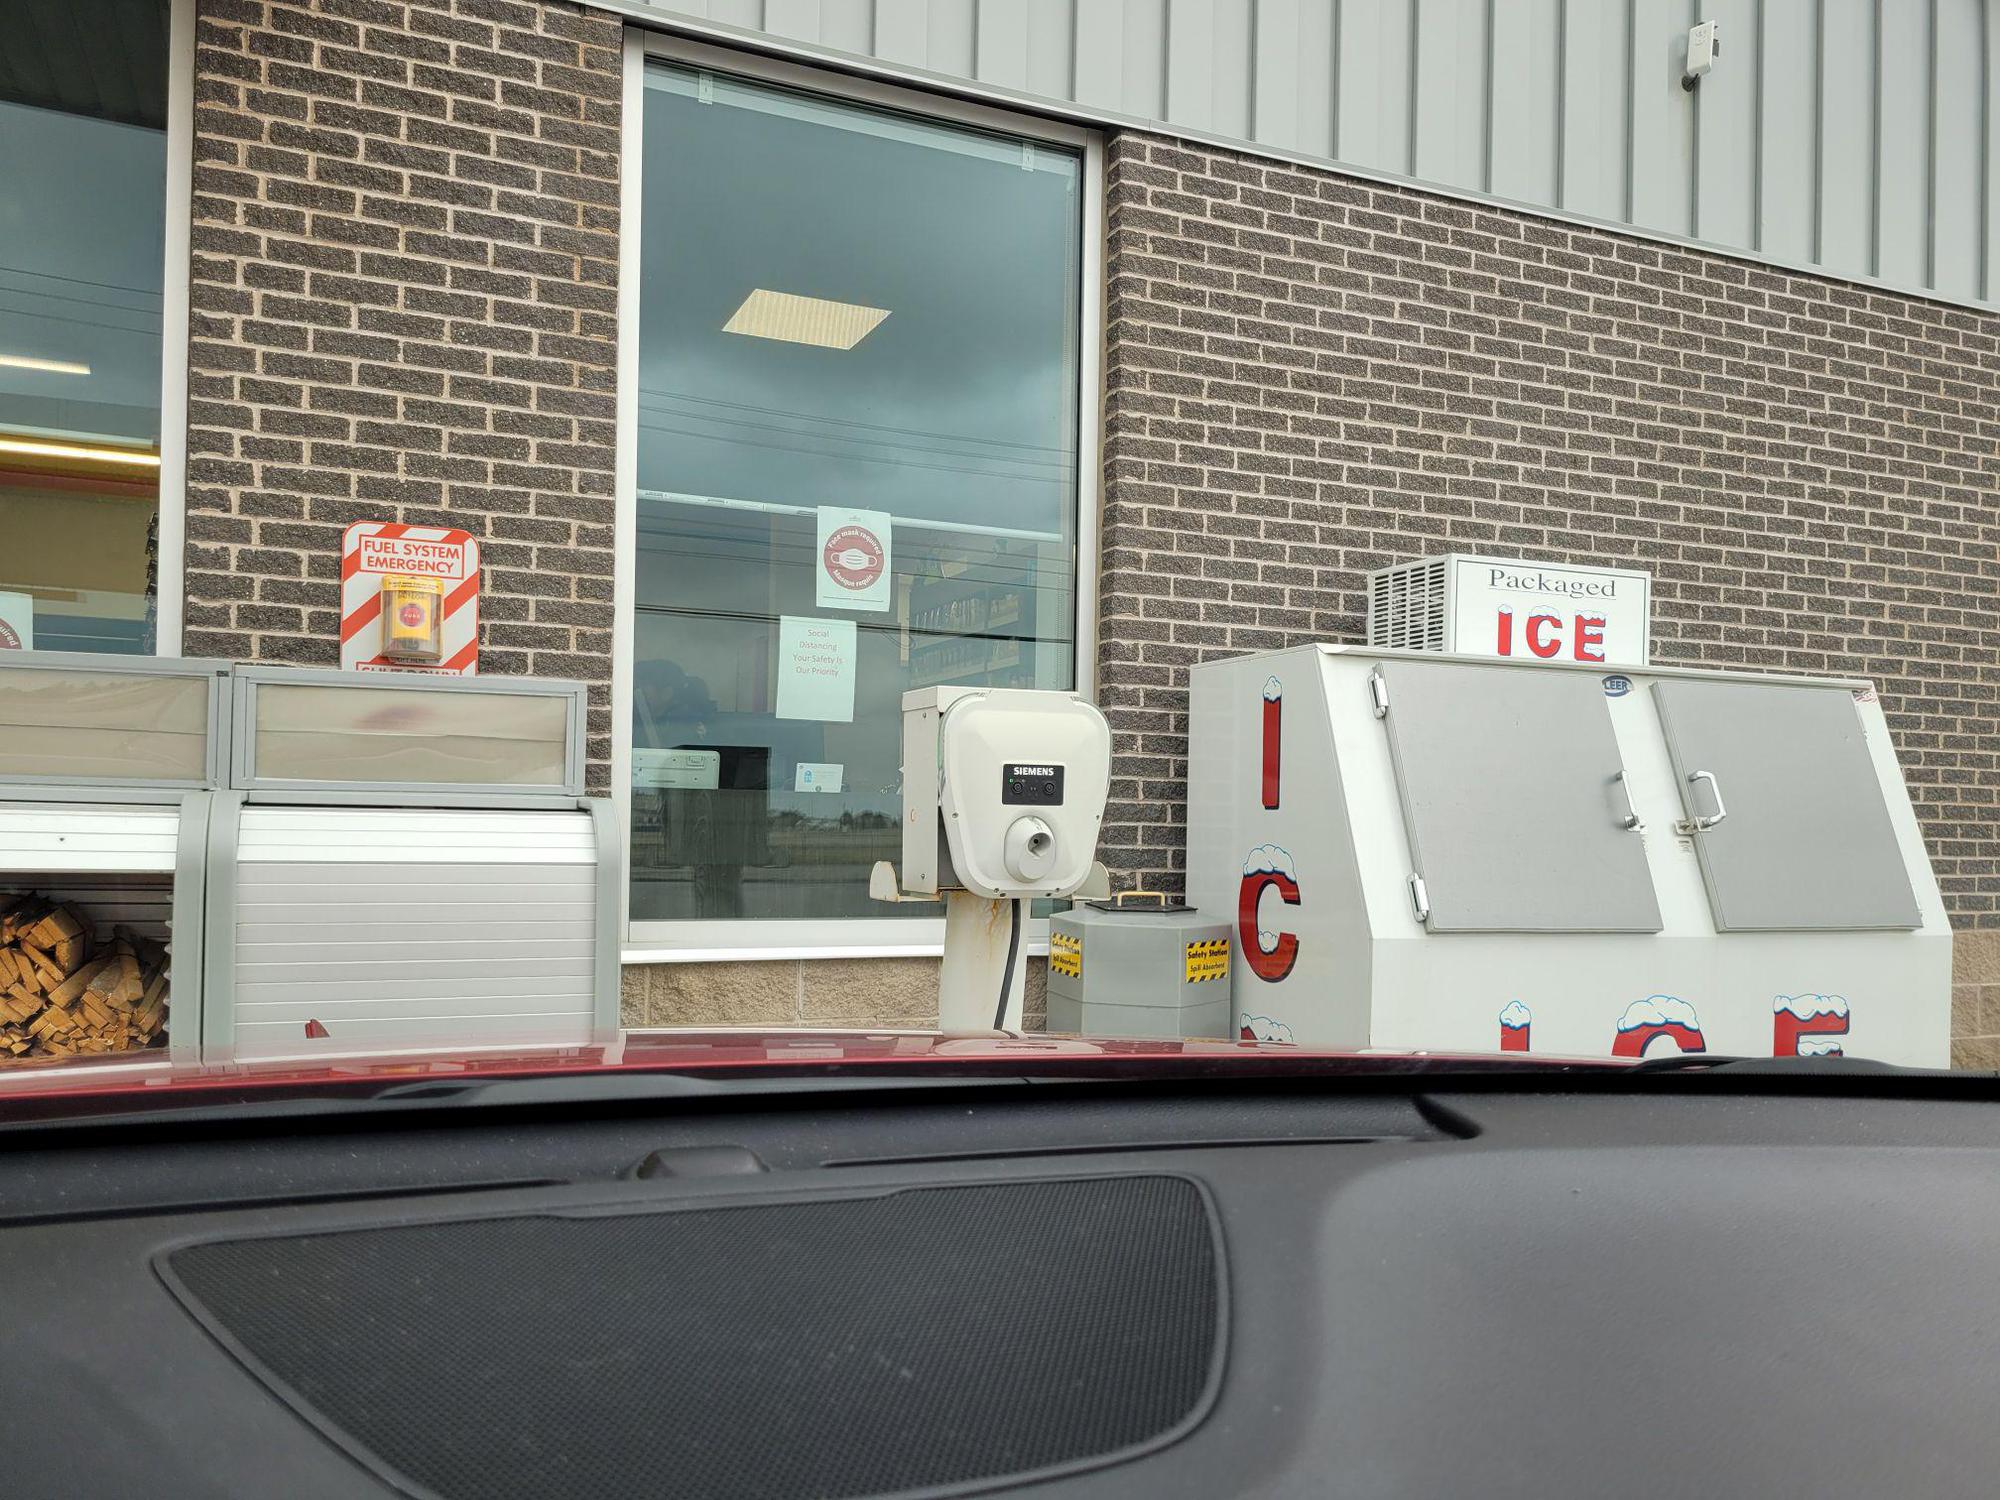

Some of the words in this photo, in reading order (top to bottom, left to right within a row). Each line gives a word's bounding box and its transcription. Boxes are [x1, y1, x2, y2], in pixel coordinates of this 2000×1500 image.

[841, 529, 859, 538] mask
[860, 532, 882, 555] required
[364, 540, 398, 554] FUEL
[403, 543, 460, 560] SYSTEM
[367, 556, 454, 574] EMERGENCY
[1489, 568, 1616, 598] Packaged
[807, 629, 829, 638] Social
[1497, 604, 1606, 662] ICE
[799, 641, 838, 651] Distancing
[793, 654, 810, 662] Your
[811, 655, 834, 664] Safety
[796, 666, 810, 674] Our
[812, 667, 839, 678] Priority
[1604, 680, 1628, 691] LEER
[1013, 767, 1054, 776] SIEMENS
[1187, 951, 1207, 959] Safety
[1209, 949, 1228, 957] Station
[1203, 962, 1225, 970] Absorbent
